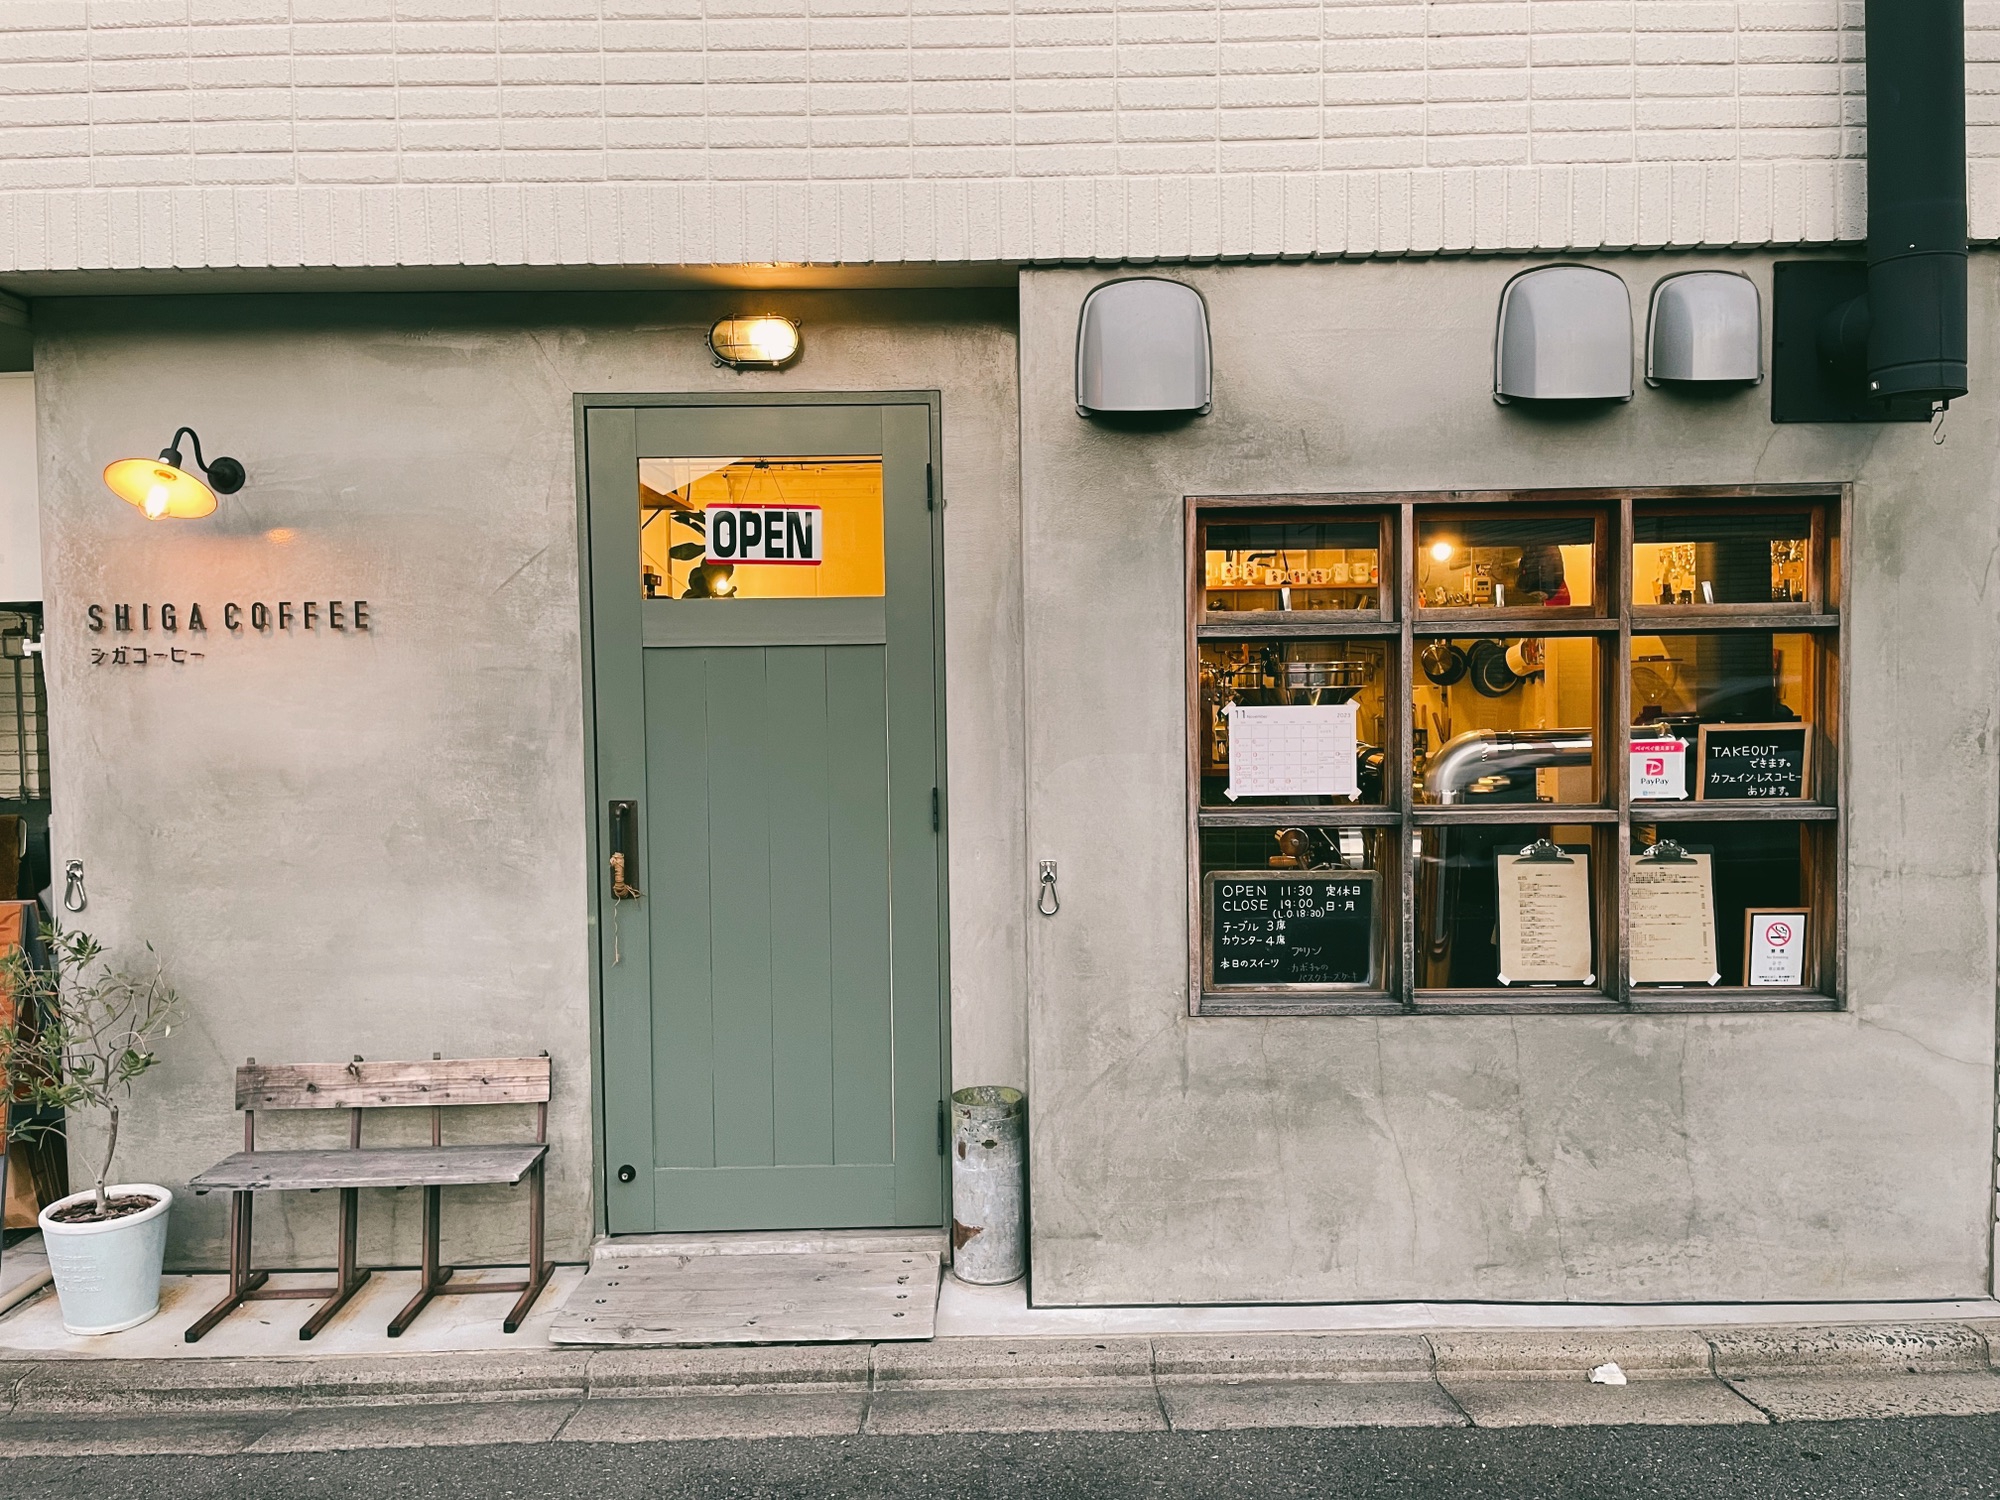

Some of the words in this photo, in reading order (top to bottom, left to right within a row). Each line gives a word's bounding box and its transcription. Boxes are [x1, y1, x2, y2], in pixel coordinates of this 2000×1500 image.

[713, 511, 813, 558] OPEN
[88, 602, 207, 631] SHIGA
[224, 600, 369, 630] COFFEE
[90, 646, 205, 665] シガコーヒー
[1235, 710, 1246, 719] 11
[1711, 745, 1779, 758] TAKEOUT
[1749, 757, 1792, 769] できます。
[1641, 778, 1669, 786] PayPay
[1747, 785, 1790, 797] あります。
[1222, 885, 1267, 897] OPEN
[1280, 885, 1313, 897] 11:30
[1325, 884, 1361, 898] 定休日
[1222, 899, 1269, 912] CLOSE
[1280, 898, 1314, 910] 19:00
[1222, 920, 1259, 933] テーブル
[1222, 935, 1262, 946] カウンター
[1291, 946, 1322, 957] プリン
[1220, 957, 1279, 969] 本日のスイーツ
